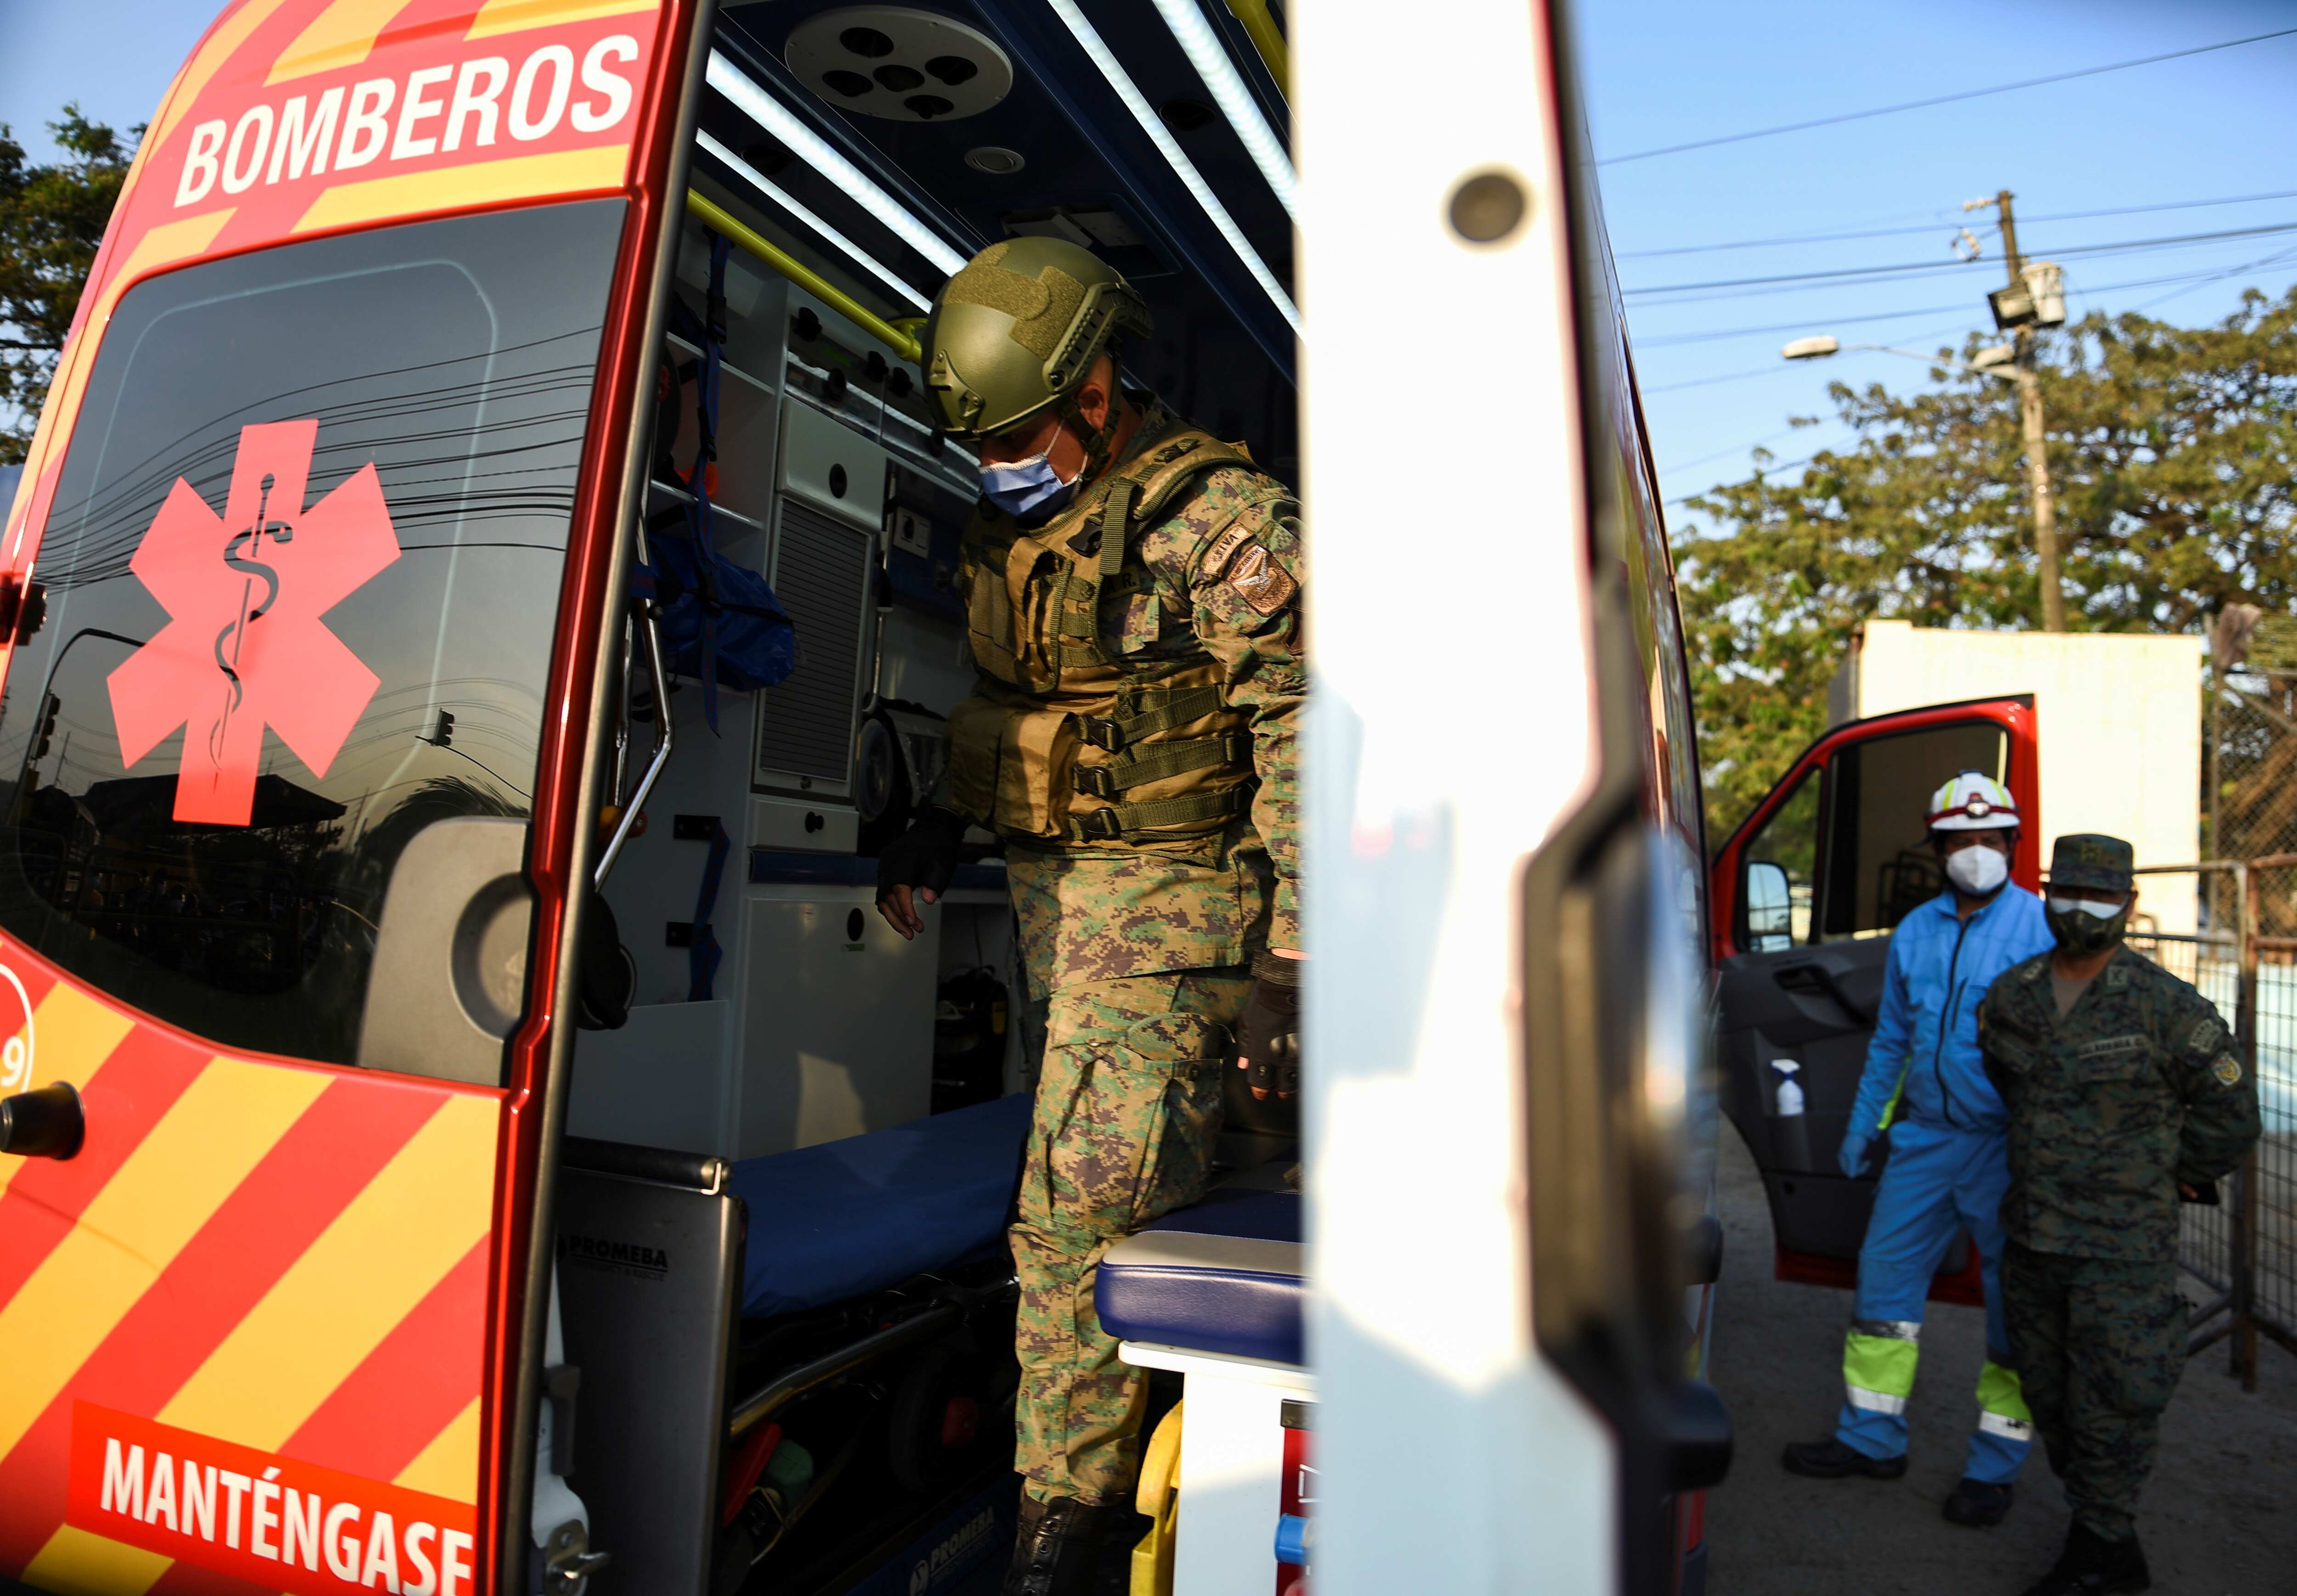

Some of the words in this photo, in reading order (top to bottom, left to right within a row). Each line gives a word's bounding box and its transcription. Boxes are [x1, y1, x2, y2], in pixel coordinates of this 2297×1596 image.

[173, 34, 639, 208] BOMBEROS
[569, 1234, 668, 1268] PROMEBA
[100, 1437, 473, 1596] MANTÉNGASE
